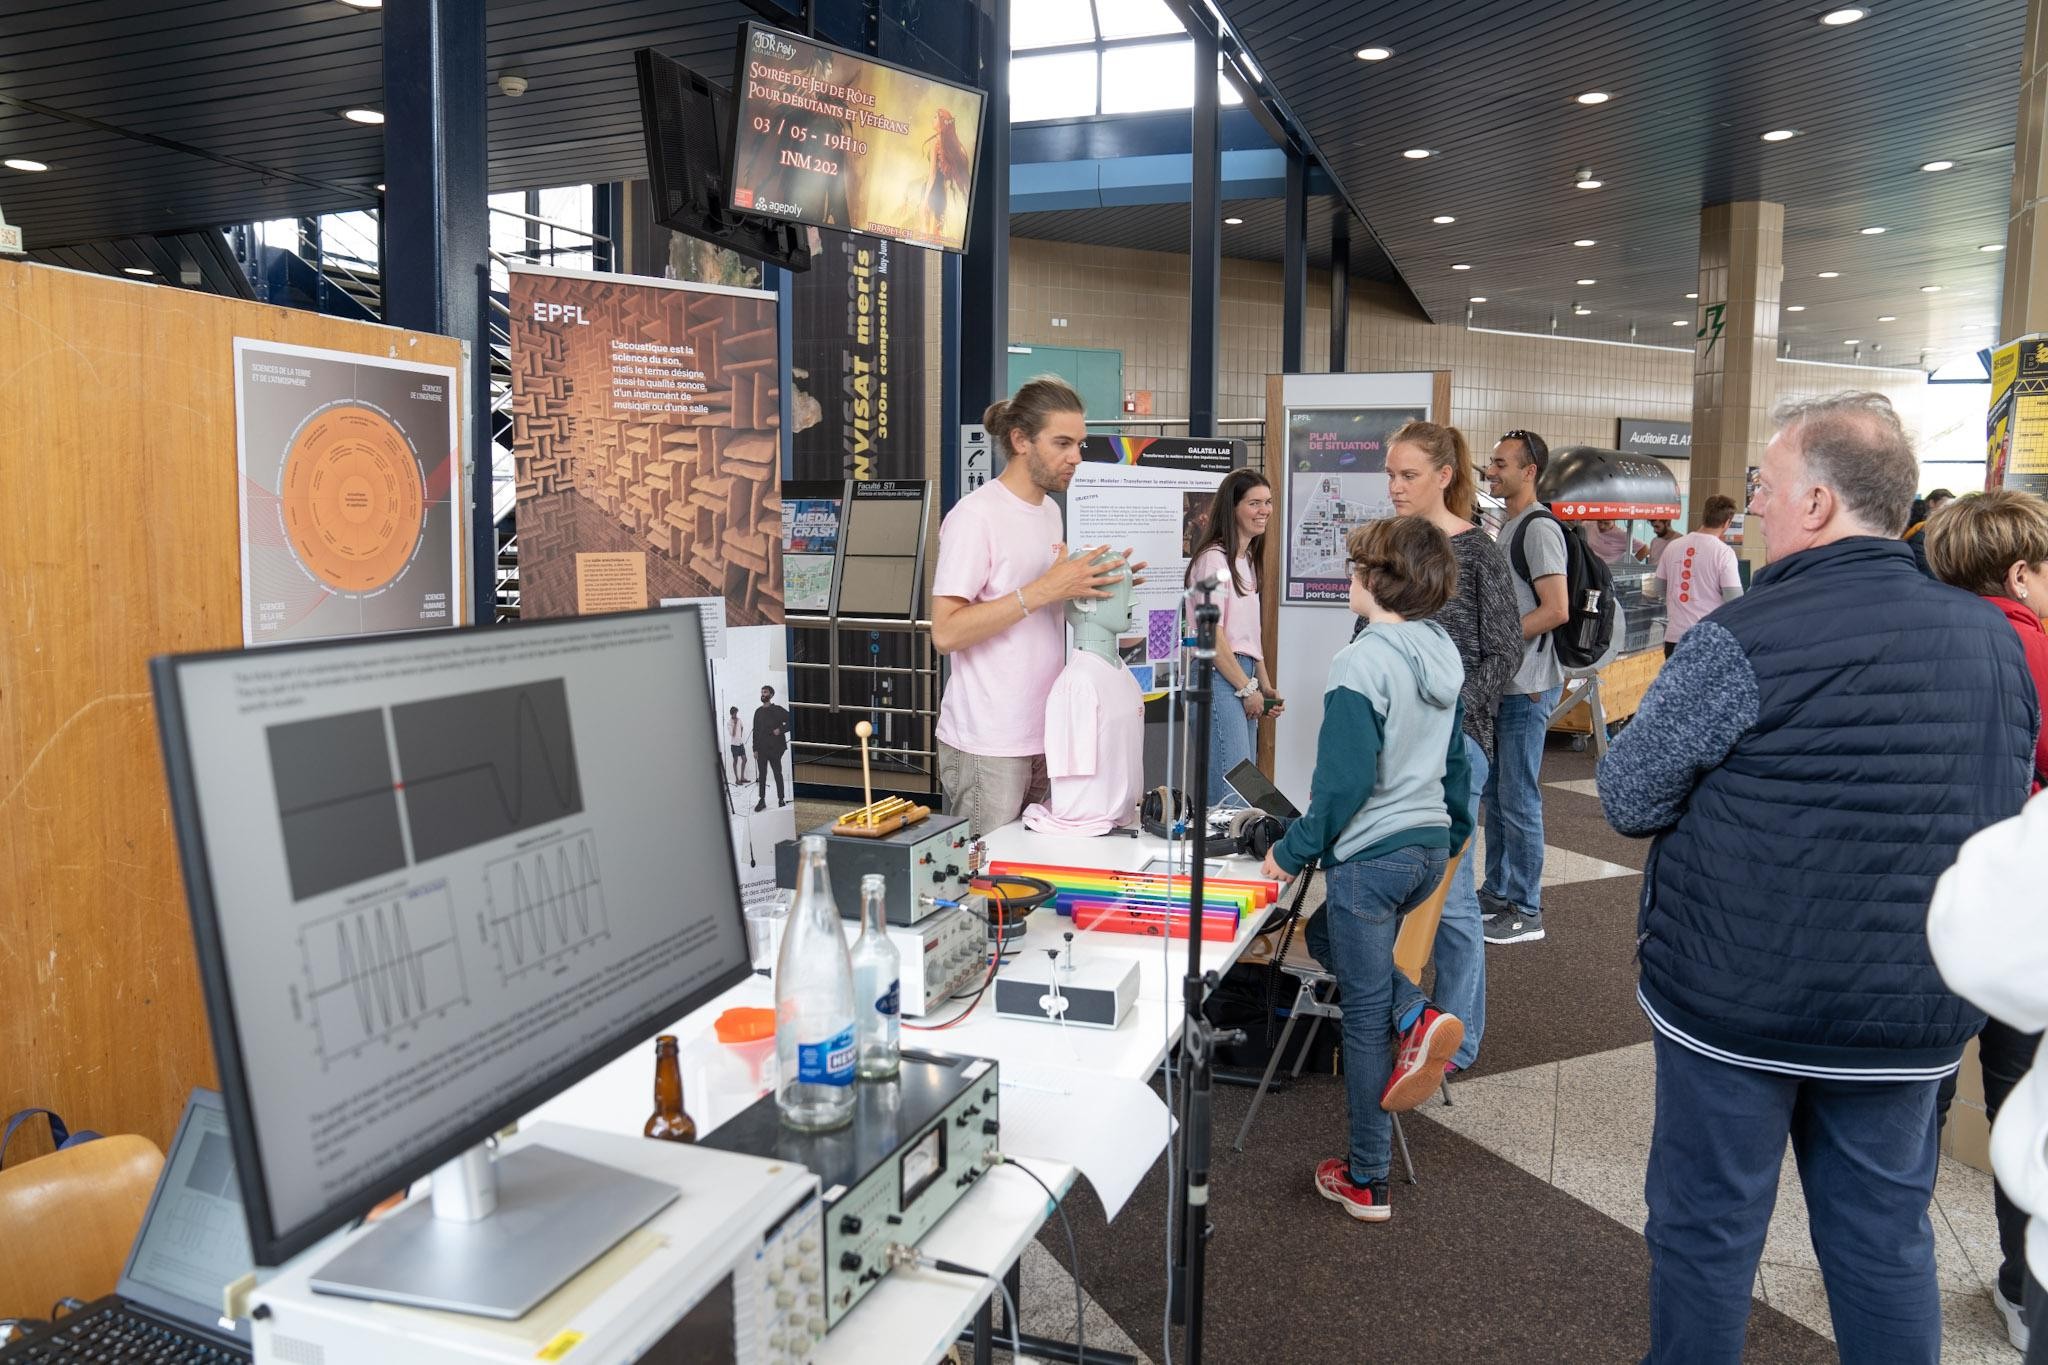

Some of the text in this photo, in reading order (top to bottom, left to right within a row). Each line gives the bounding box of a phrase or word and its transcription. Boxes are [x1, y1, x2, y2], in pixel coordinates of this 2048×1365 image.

[754, 33, 797, 61] JDR Poly
[753, 116, 771, 132] 03
[791, 125, 808, 142] 05
[814, 159, 838, 176] 202
[768, 200, 802, 217] agepoly
[878, 239, 889, 274] May-June
[853, 249, 870, 345] meris
[533, 302, 590, 326] EPFL
[611, 340, 694, 354] L'acoustique est la
[612, 353, 682, 366] science du son,
[877, 280, 889, 439] 300m composite
[612, 365, 704, 379] mais le terme désigne
[613, 377, 636, 386] aussi
[637, 377, 645, 387] la
[646, 378, 676, 389] qualité
[613, 388, 692, 401] d'un instrument de
[613, 401, 651, 411] musique
[664, 402, 688, 412] d'une
[689, 404, 709, 413] salle
[1309, 432, 1337, 441] PLAN
[1629, 431, 1668, 445] Auditoire
[1188, 447, 1217, 455] GALATEA
[1309, 442, 1380, 450] DE SITUATION
[858, 482, 896, 490] Faculté STI
[796, 512, 836, 523] MEDIA
[793, 527, 836, 538] CRASH
